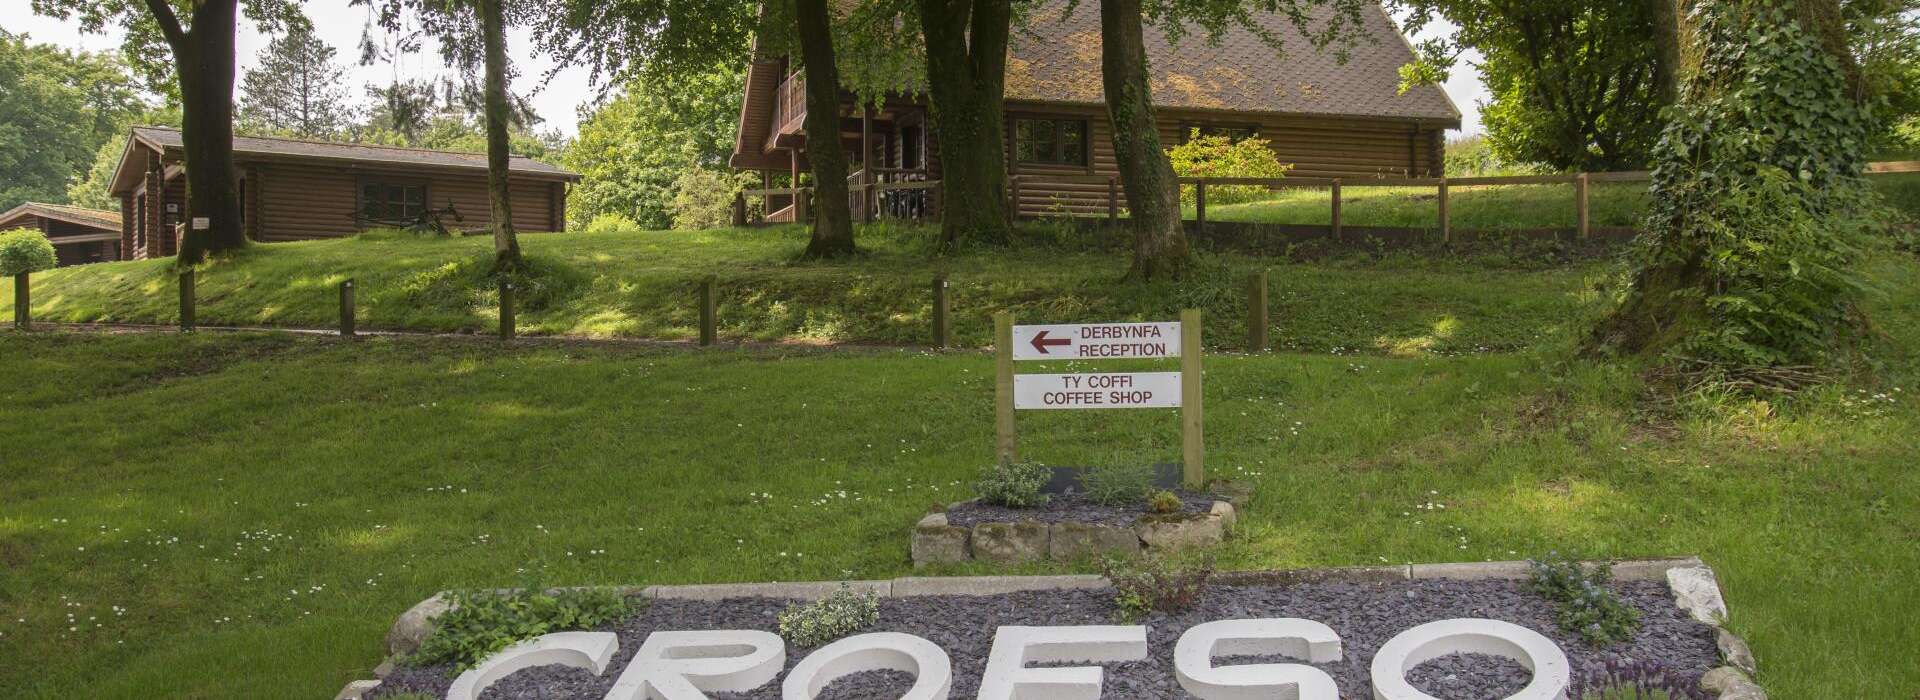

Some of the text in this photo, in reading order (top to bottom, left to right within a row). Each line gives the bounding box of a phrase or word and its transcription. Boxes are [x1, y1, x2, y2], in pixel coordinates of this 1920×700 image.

[1081, 326, 1161, 339] DERBYNFA
[1079, 343, 1166, 357] RECEPTION
[1062, 375, 1133, 388] TY COFFI
[1043, 391, 1153, 405] COFFEE SHOP
